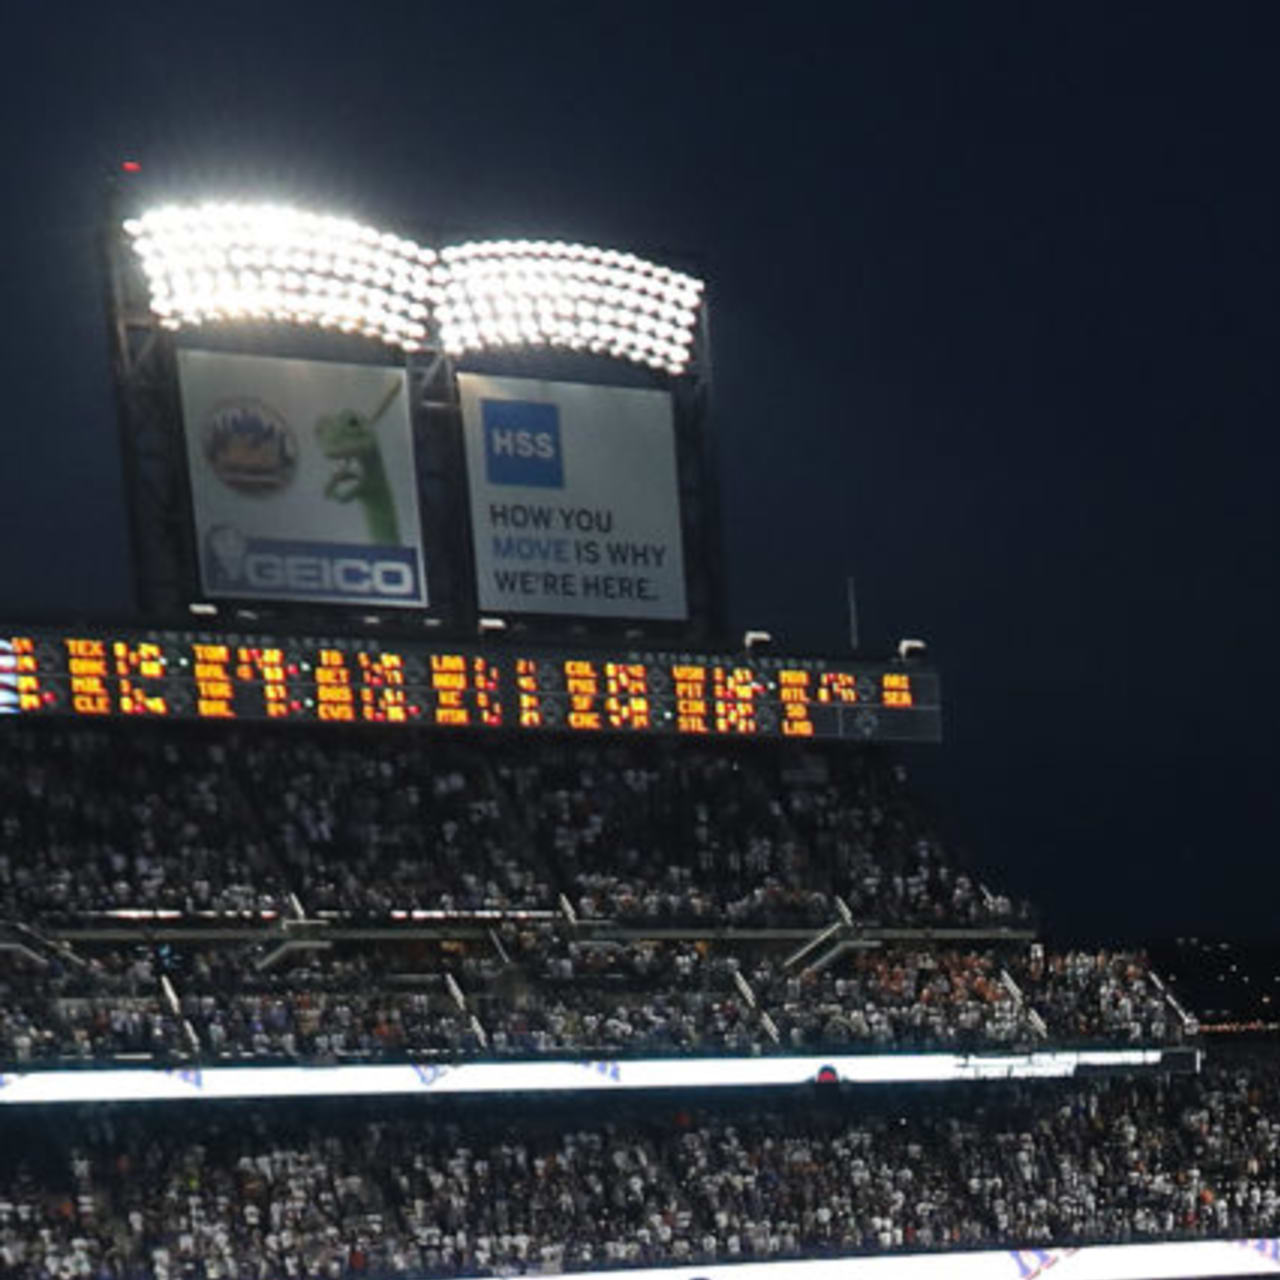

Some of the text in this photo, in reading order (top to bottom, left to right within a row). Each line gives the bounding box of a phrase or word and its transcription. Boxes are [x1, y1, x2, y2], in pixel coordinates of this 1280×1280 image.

[492, 432, 555, 459] HSS
[490, 504, 612, 534] HOW YOU
[494, 536, 667, 568] MOVE IS WHY
[244, 553, 415, 595] GEICO
[494, 570, 577, 597] WE'RE
